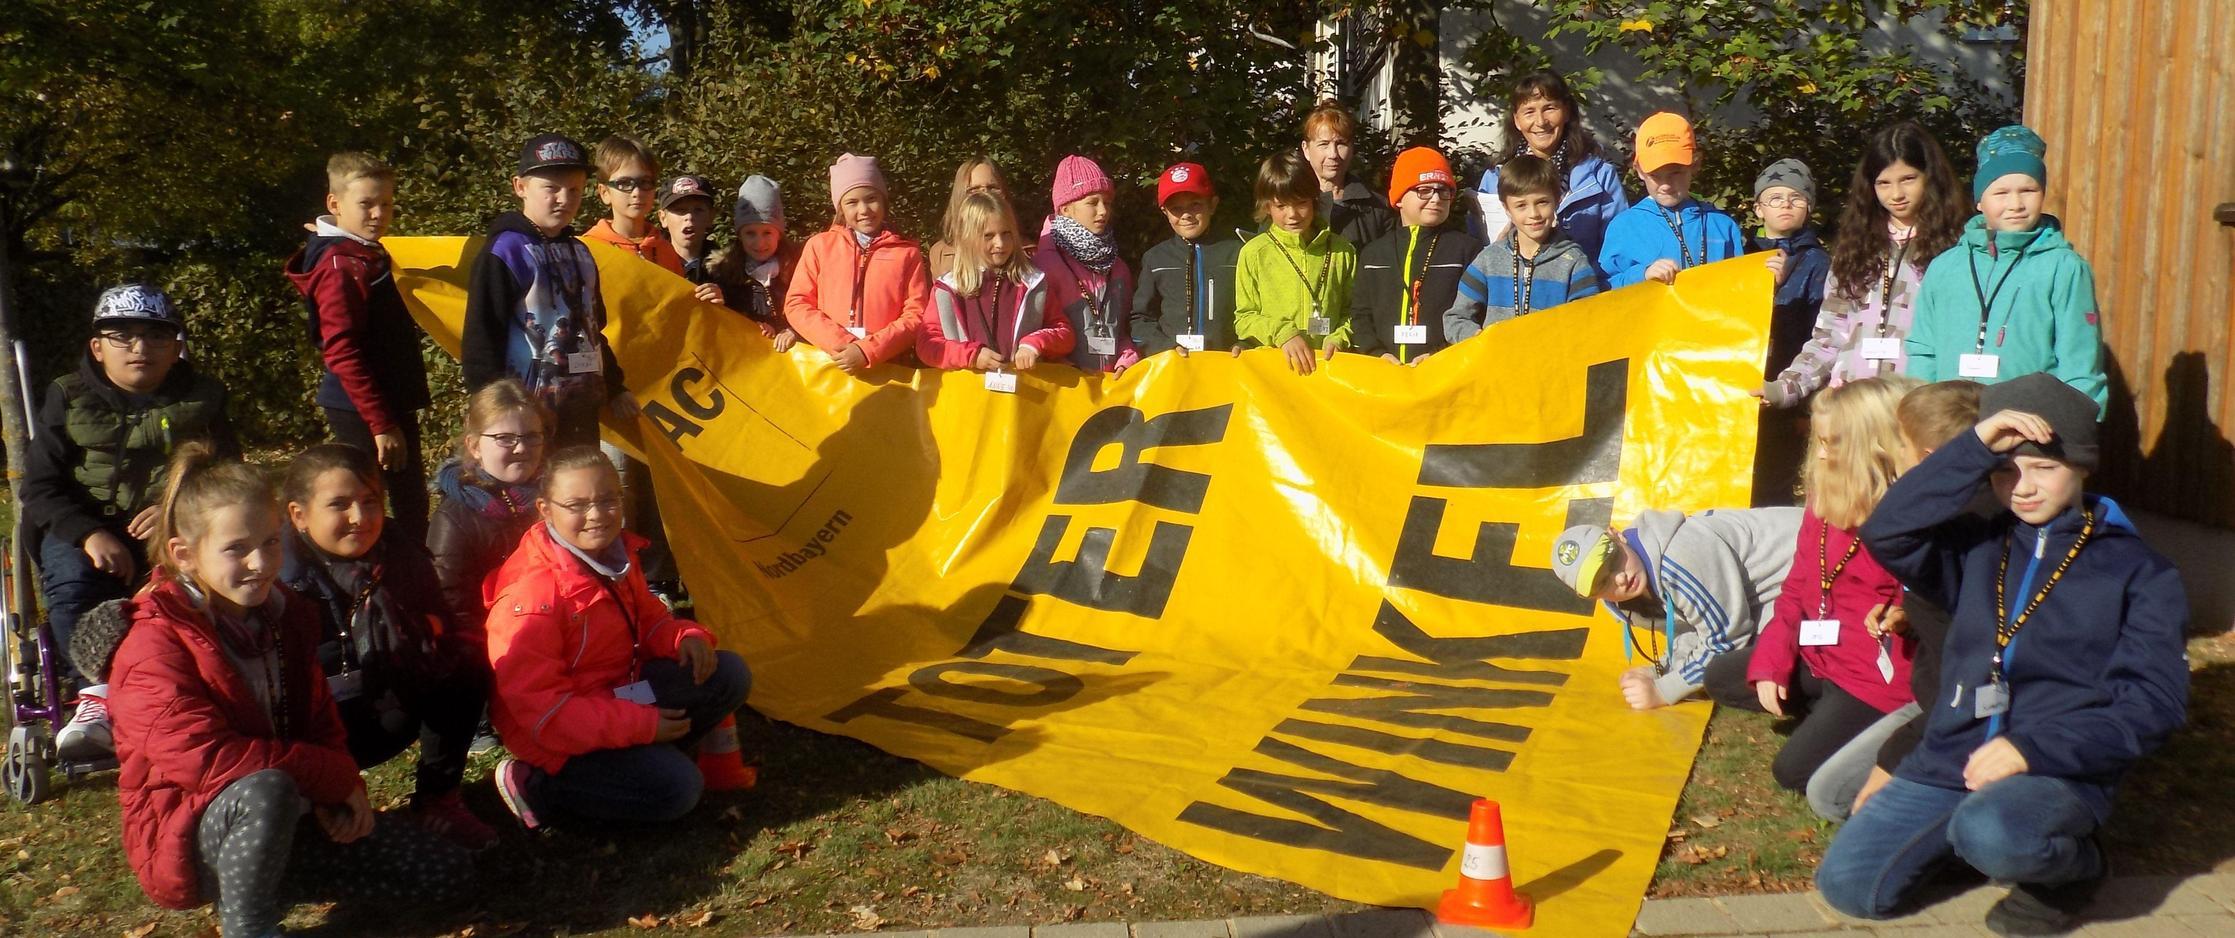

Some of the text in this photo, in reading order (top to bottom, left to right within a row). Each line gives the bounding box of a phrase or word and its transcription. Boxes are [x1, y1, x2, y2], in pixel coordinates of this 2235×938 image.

[752, 509, 854, 579] Nordbayern
[822, 402, 1234, 745] TOTER
[1176, 357, 1630, 873] WINKEL
